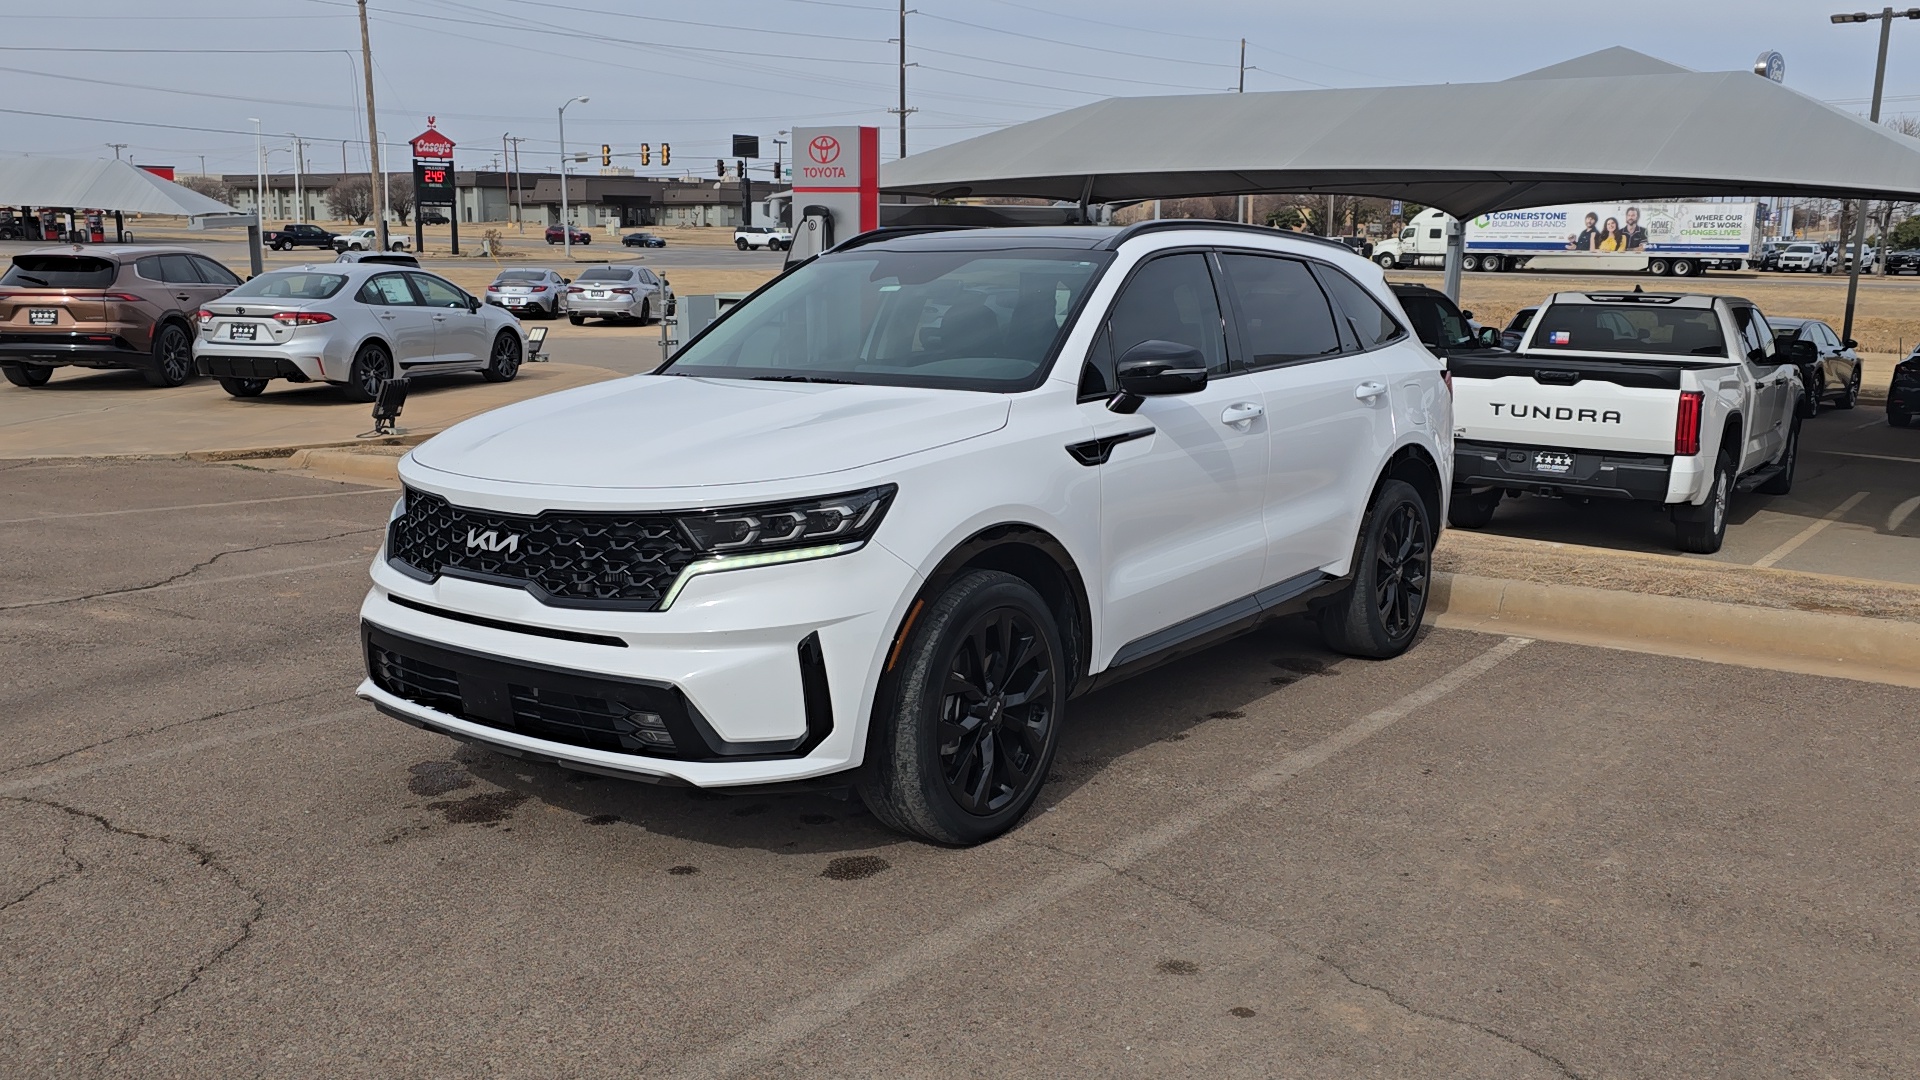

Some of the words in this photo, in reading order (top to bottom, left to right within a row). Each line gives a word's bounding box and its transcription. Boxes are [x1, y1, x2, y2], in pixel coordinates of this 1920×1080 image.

[417, 139, 451, 155] Casey's
[803, 166, 846, 178] TOYOTA
[1493, 212, 1567, 220] CORNERSTONE
[1492, 220, 1529, 228] BUILDING
[1532, 220, 1567, 228] BRANDS
[1651, 220, 1670, 229] HOME
[1692, 221, 1715, 229] LIFE'S
[1717, 221, 1742, 229] WORK
[1488, 402, 1621, 424] TUNDRA
[466, 527, 521, 554] KIA
